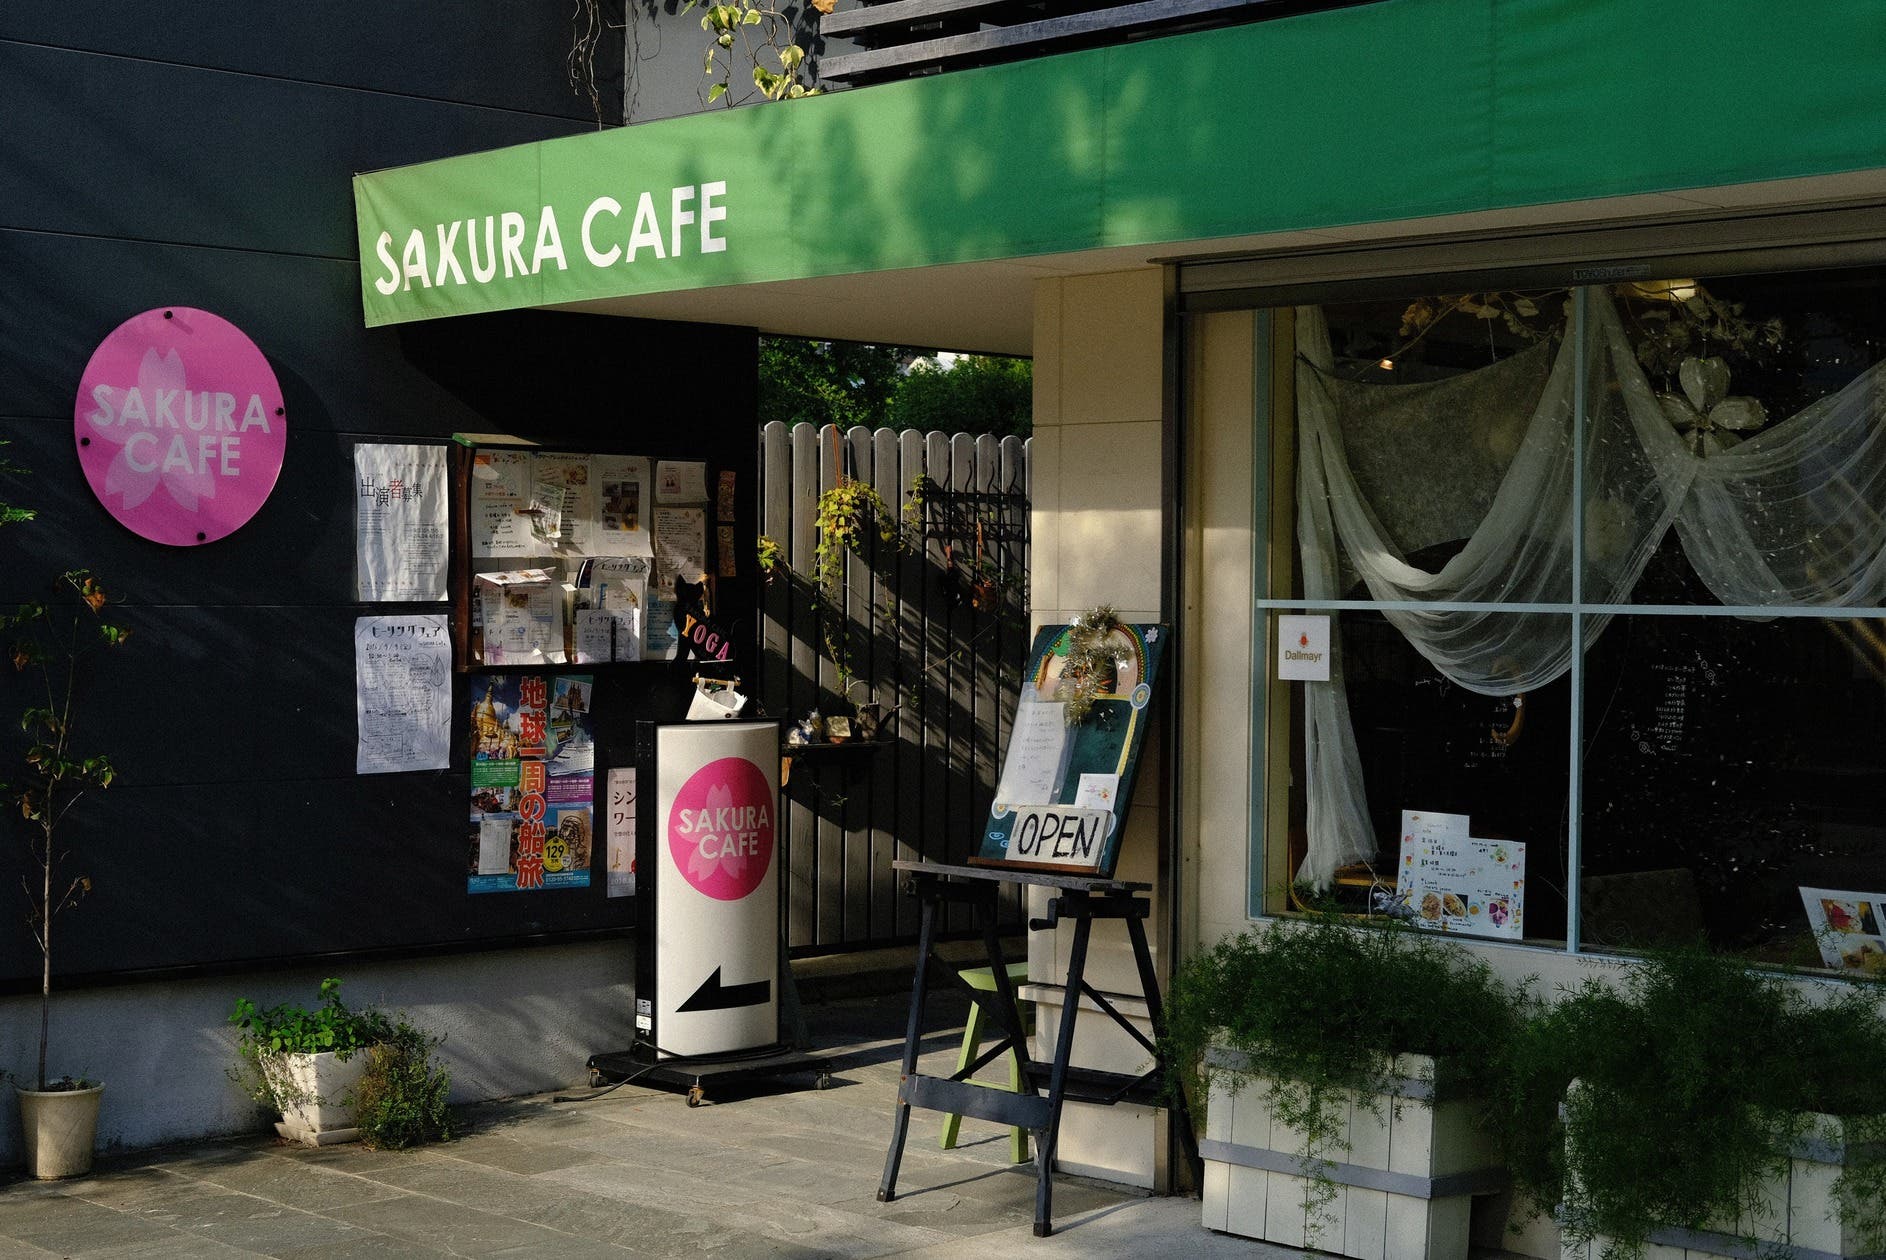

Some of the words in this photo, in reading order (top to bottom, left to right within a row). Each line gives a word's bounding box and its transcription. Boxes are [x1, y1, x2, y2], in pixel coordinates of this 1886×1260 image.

[375, 205, 568, 295] SAKURA
[581, 180, 727, 268] CAFE
[92, 383, 271, 434] SAKURA
[123, 431, 241, 477] CAFE
[361, 476, 423, 507] 出演者募集
[681, 613, 731, 661] YOGA
[1284, 650, 1323, 663] Dallmayr
[516, 677, 547, 889] 地球一周の船旅
[678, 804, 770, 834] SAKURA
[1017, 812, 1100, 859] OPEN
[545, 844, 565, 859] 129
[698, 831, 759, 861] CAFE
